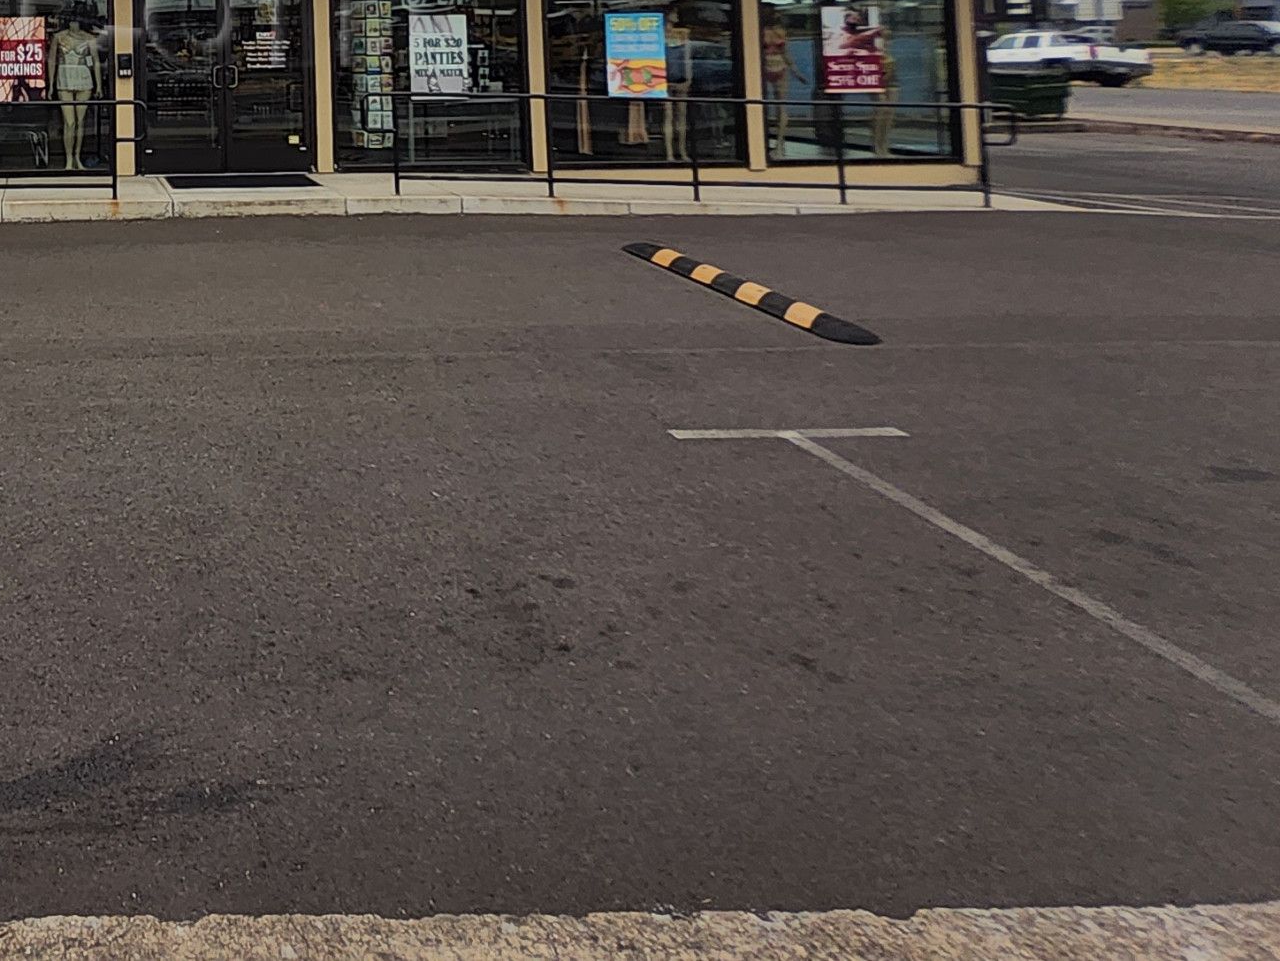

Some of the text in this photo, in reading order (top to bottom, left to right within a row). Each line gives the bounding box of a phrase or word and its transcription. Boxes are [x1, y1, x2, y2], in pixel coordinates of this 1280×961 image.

[423, 38, 441, 48] FOR
[0, 51, 16, 62] FOR
[17, 43, 43, 62] $25
[414, 51, 464, 66] PANTIES
